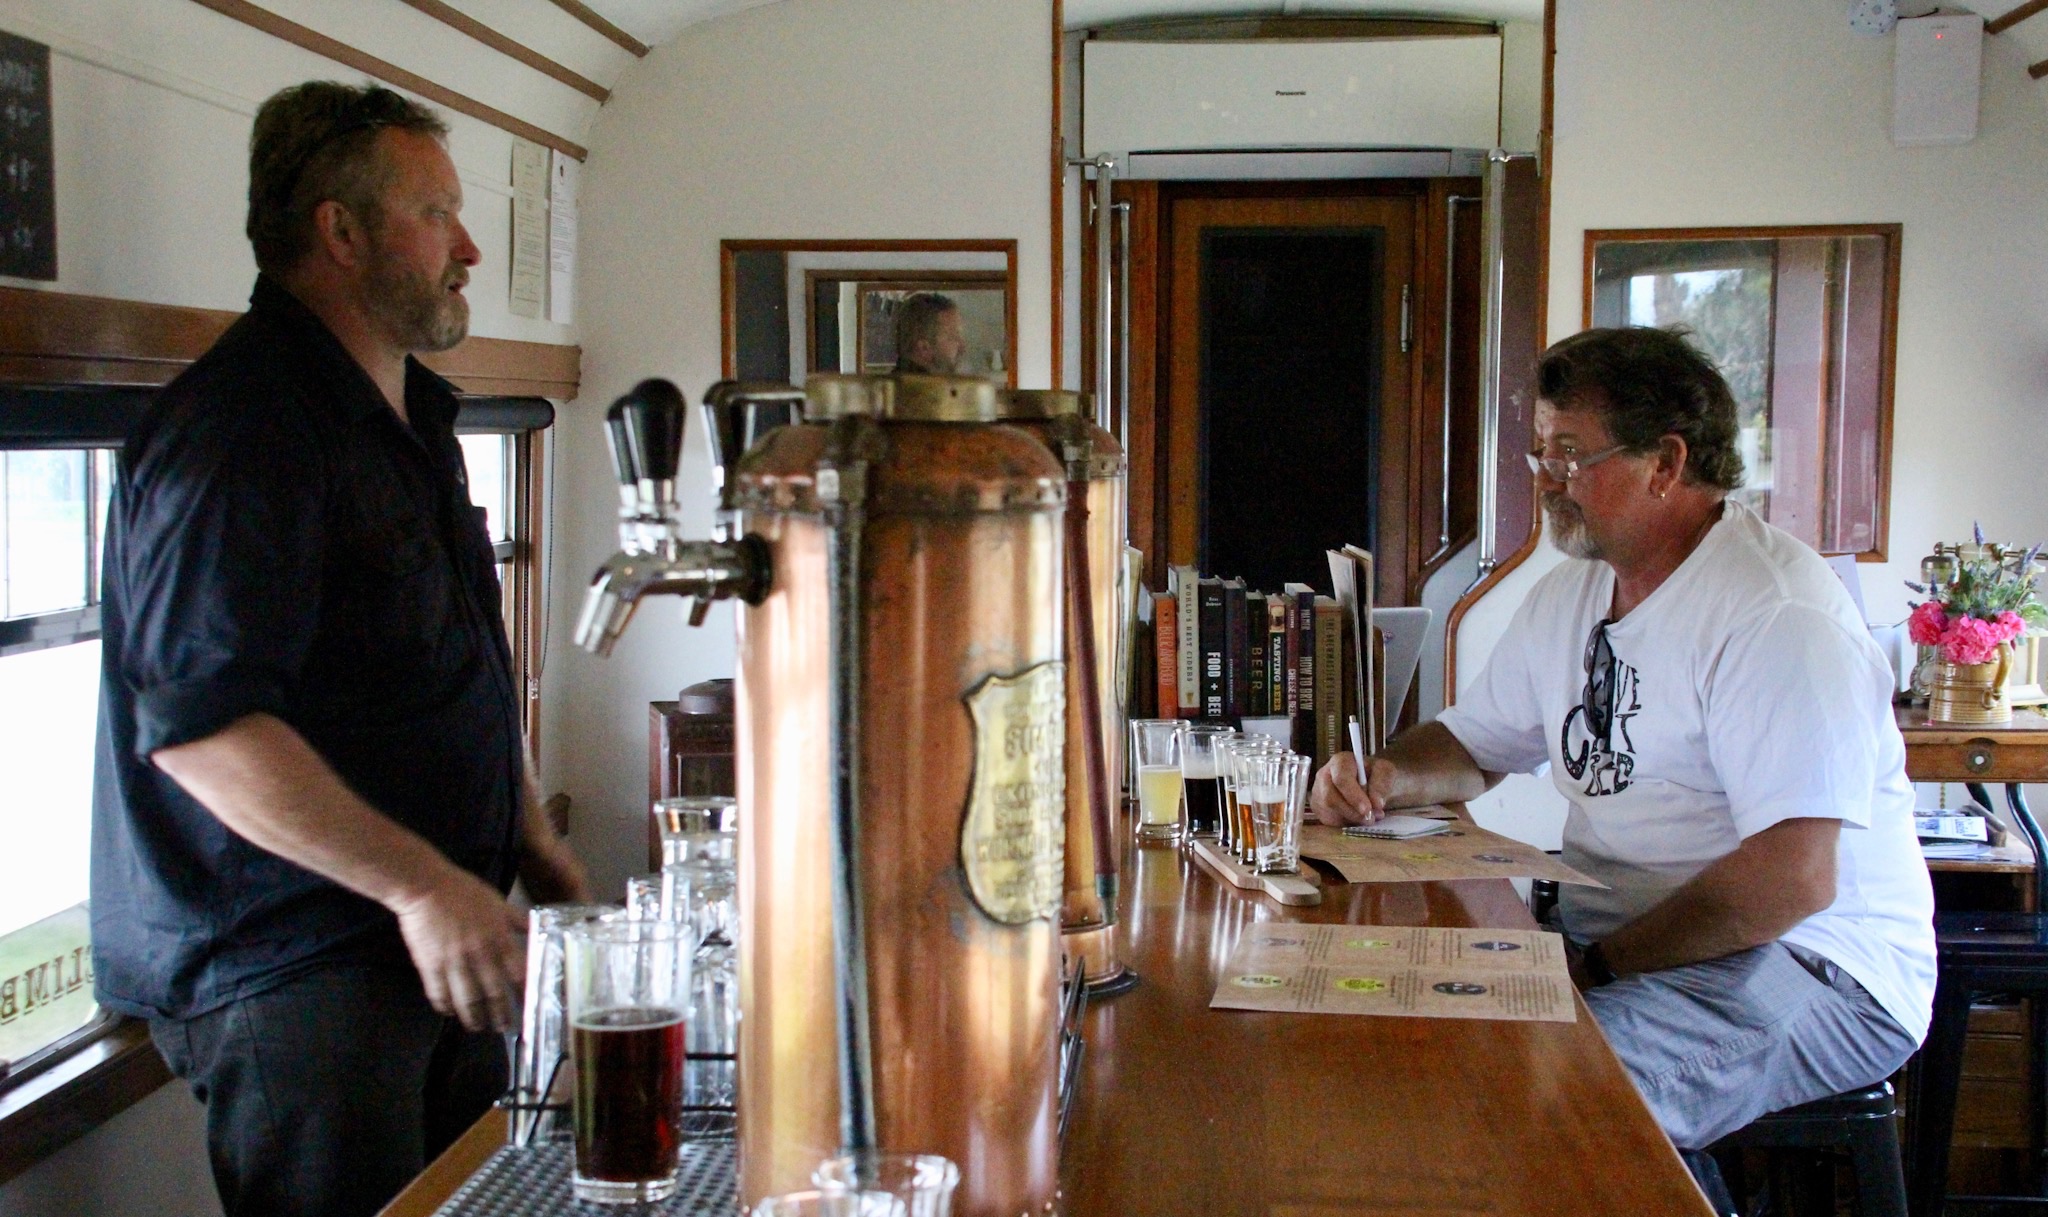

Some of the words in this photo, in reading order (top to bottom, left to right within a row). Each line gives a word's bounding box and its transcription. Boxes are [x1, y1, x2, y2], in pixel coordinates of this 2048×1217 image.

[1300, 609, 1310, 630] PALMER
[1159, 626, 1173, 647] BEER
[1159, 648, 1174, 665] AND
[1207, 652, 1221, 677] FOOD
[1273, 636, 1281, 682] TASTING
[1299, 656, 1312, 675] HOW
[1160, 665, 1174, 685] FOOD
[1252, 647, 1263, 690] BEER
[1210, 683, 1218, 691] +
[1288, 668, 1296, 694] CHEESE
[1299, 676, 1312, 687] TO
[1207, 696, 1221, 717] BEE
[1273, 684, 1281, 711] BEER
[1299, 688, 1312, 711] BREW
